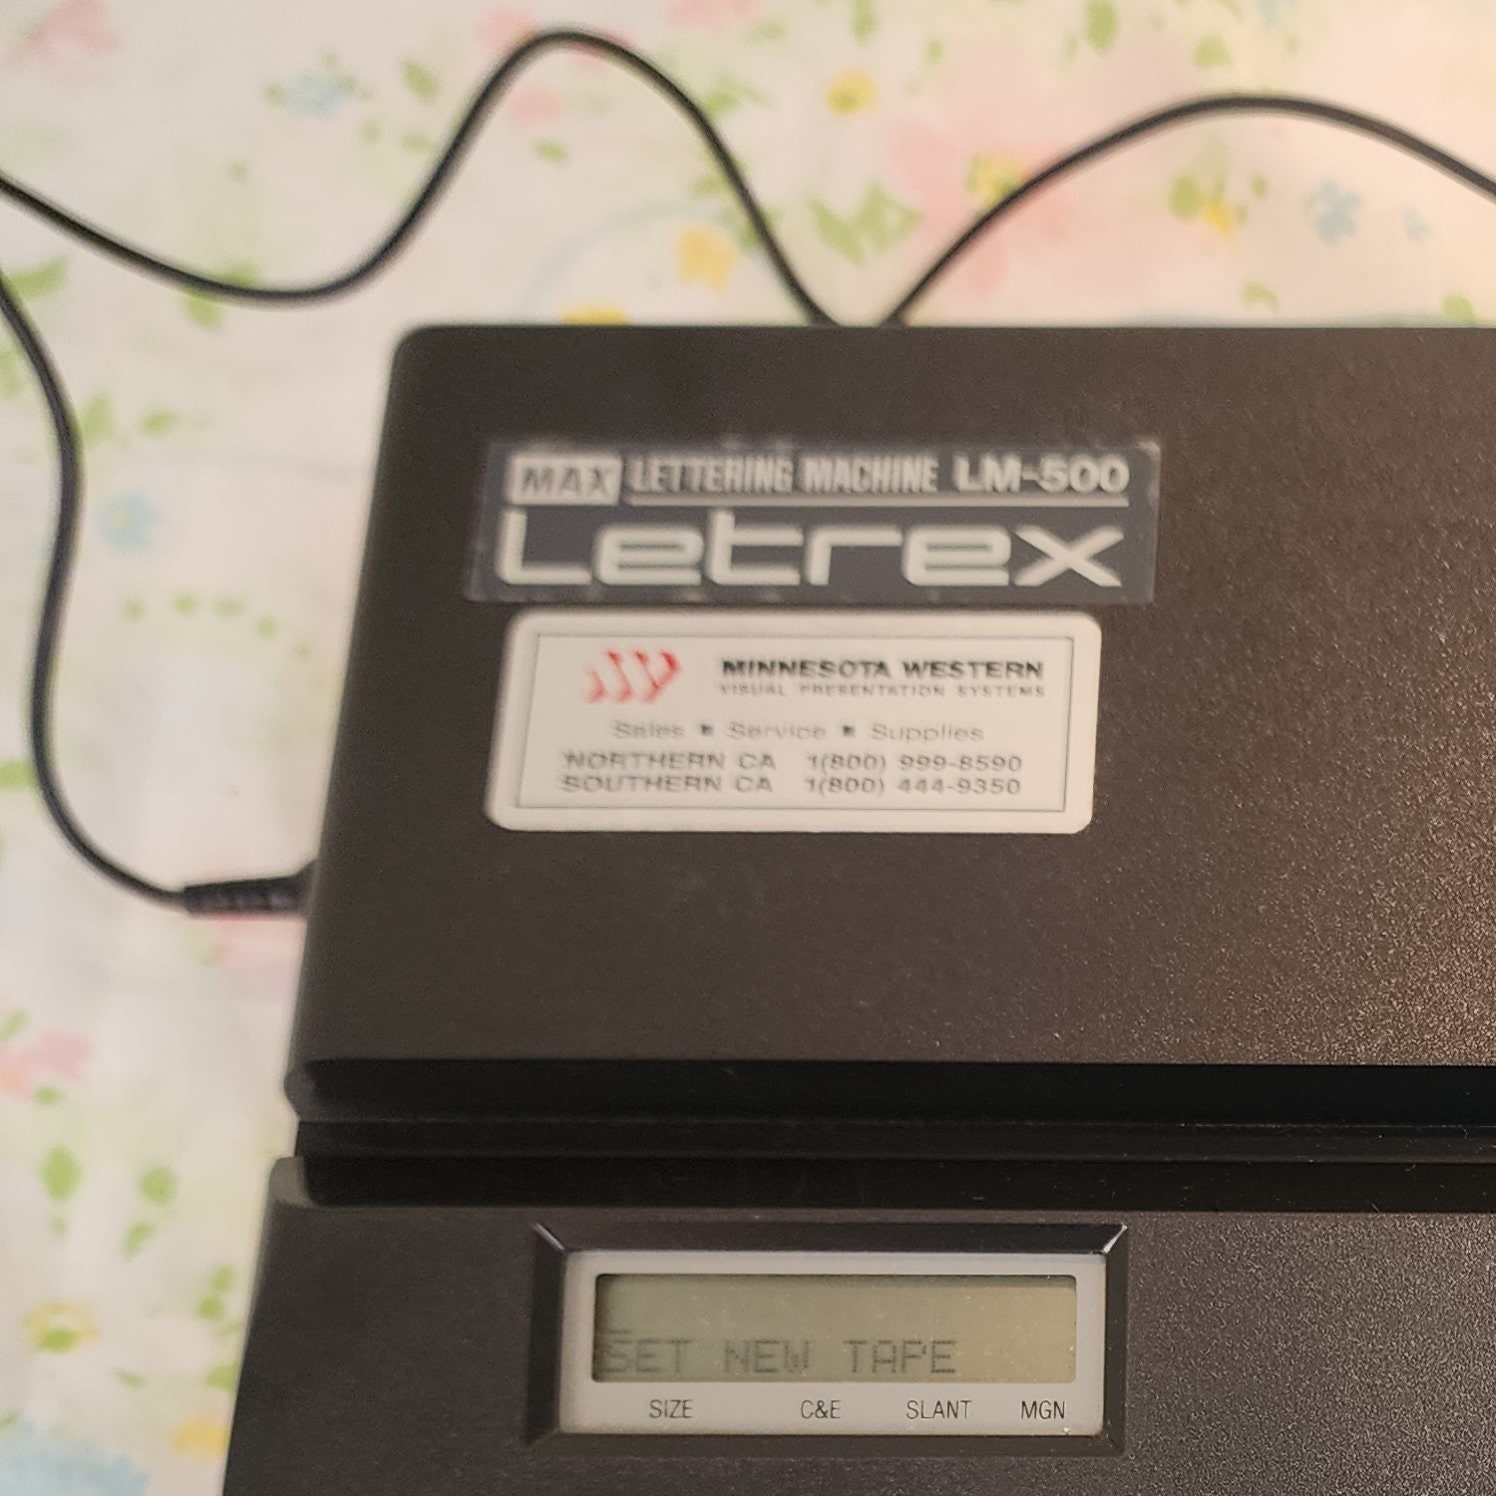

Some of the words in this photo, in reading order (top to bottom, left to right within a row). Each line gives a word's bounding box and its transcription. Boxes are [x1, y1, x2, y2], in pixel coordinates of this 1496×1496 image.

[520, 463, 611, 498] MAX
[630, 456, 795, 495] LETTERING
[803, 457, 937, 494] MACHINE
[953, 454, 1130, 494] LM-500
[497, 508, 1124, 586] Letrex
[722, 659, 891, 679] MINNESOTA
[902, 660, 1044, 679] WESTERN
[719, 683, 786, 696] VISUAL
[800, 684, 946, 697] PRESENTATION
[957, 684, 1046, 698] SYSTEMS
[613, 720, 685, 739] Sales
[727, 721, 827, 739] Service
[871, 723, 984, 743] Supplies
[562, 752, 726, 770] NORTHERN
[738, 753, 776, 770] CA
[806, 754, 887, 775] 1(800)
[561, 774, 723, 793] SOUTHERN
[735, 776, 774, 793] CA
[804, 777, 885, 798] 1(800)
[897, 777, 1021, 796] 444-9350
[604, 1339, 691, 1373] SET
[725, 1339, 810, 1373] NEW
[844, 1340, 956, 1373] TAPE
[649, 1400, 694, 1419] SIZE
[800, 1400, 841, 1420] C&E
[906, 1400, 972, 1420] SLANT
[1020, 1401, 1066, 1420] MGN
